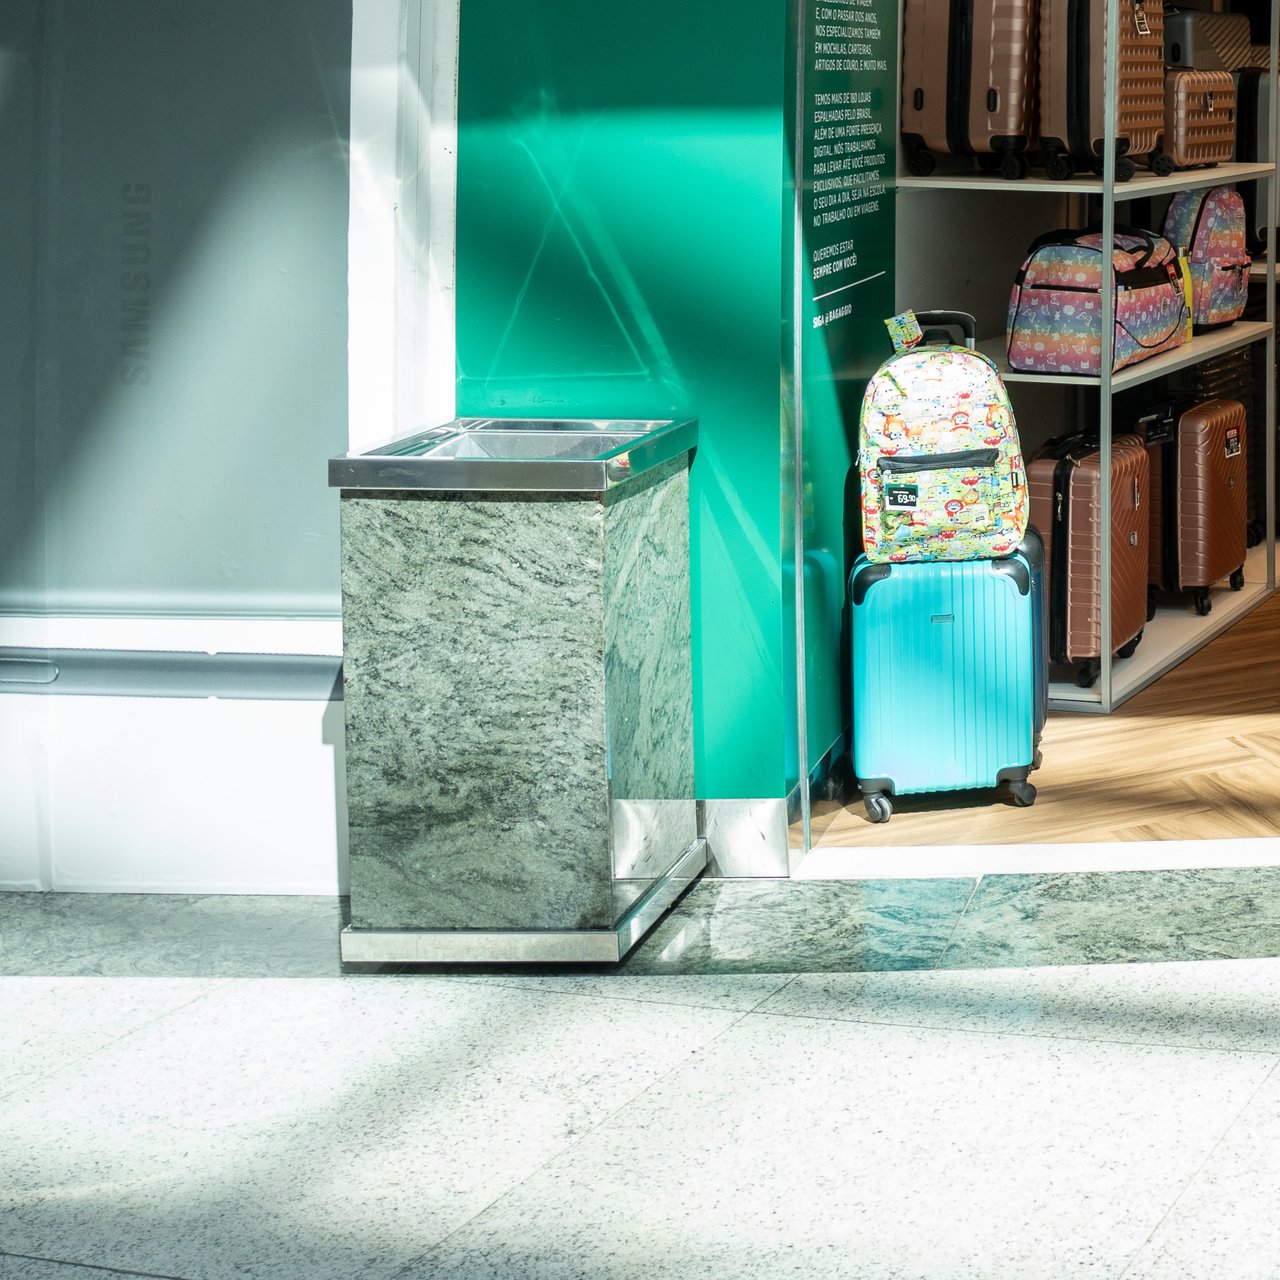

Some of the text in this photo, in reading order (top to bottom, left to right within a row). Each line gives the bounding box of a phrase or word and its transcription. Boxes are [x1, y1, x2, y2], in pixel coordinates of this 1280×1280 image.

[821, 8, 832, 20] COM
[838, 9, 854, 21] PASSAR
[855, 11, 864, 22] DOS
[827, 25, 863, 39] ESPECIALIZAMOS
[864, 26, 881, 40] TAMBÉM
[815, 42, 822, 54] EM
[815, 59, 835, 71] ARTIGOS
[836, 59, 842, 71] DE
[864, 60, 876, 71] MUITO
[815, 93, 831, 106] TEMOS
[831, 92, 842, 104] MAIS
[843, 92, 850, 104] DE
[858, 91, 871, 103] LOJAS
[814, 109, 844, 123] ESPALHADAS
[844, 108, 856, 120] PELO
[814, 123, 882, 140] ALÉM DE UMA FORTE PRESENÇA
[844, 139, 876, 153] TRABALHAMOS
[814, 153, 886, 175] PARA LEVAR ATÉ VOCÊ PRODUTOS
[843, 174, 853, 187] QUE
[819, 195, 828, 208] SEU
[829, 194, 837, 206] DIA
[852, 189, 862, 200] SEJA
[863, 186, 869, 198] NA
[813, 214, 821, 227] NO
[822, 208, 846, 225] TRABALHO
[847, 206, 853, 219] OU
[854, 205, 860, 216] EM
[813, 239, 854, 262] QUEREMOS ESTAR
[813, 252, 858, 280] SEMPRE COM VOCÊ!
[120, 182, 151, 386] SAMSUNG
[813, 315, 825, 329] SIGA
[898, 494, 916, 503] 69,90
